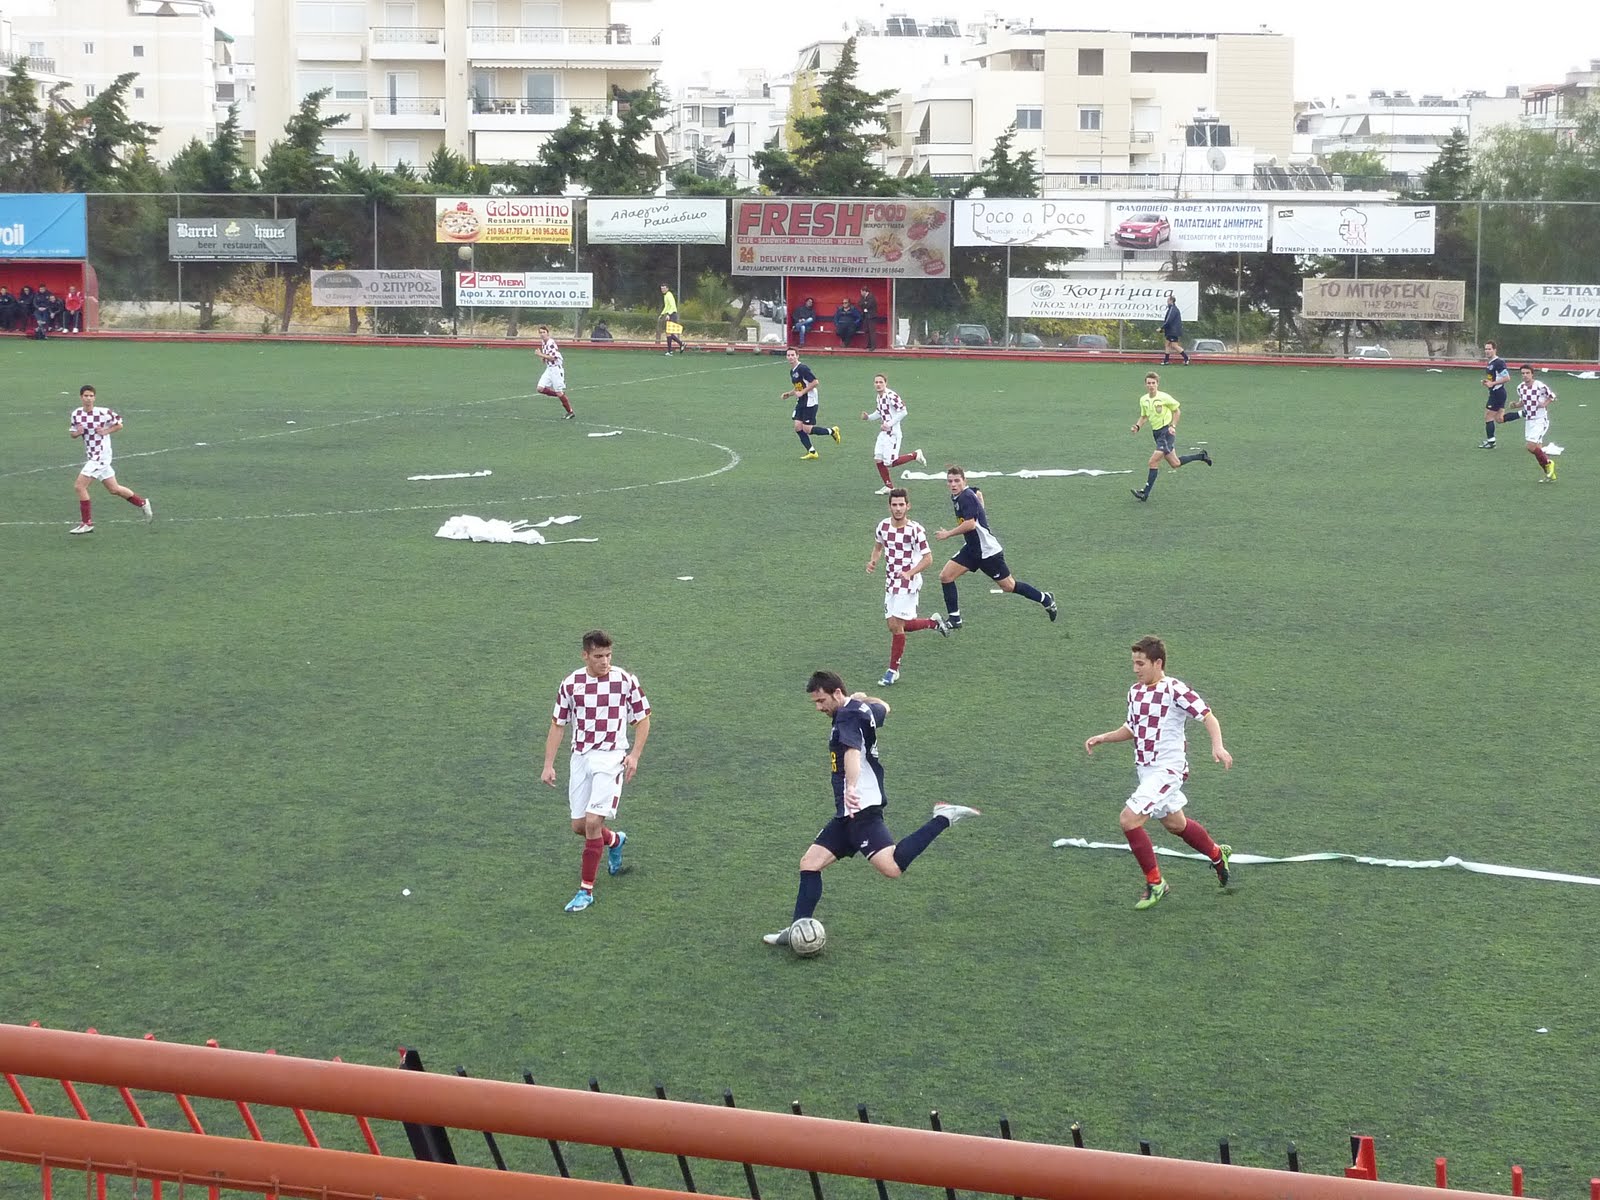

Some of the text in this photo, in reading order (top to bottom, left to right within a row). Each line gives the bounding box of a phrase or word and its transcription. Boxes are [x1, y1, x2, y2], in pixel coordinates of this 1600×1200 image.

[486, 201, 569, 217] Gelsomino
[971, 203, 1086, 227] Poco a Poco
[737, 202, 906, 236] FRESH FOOD
[1223, 218, 1263, 229] ΔΗΜΗΤΡΗΣ
[176, 223, 285, 239] Barrel haus
[197, 241, 267, 250] beer restaurant
[760, 255, 797, 263] DELIVERY
[499, 290, 566, 299] ΖΩΓΟΠΟΥΛΟΙ
[1062, 283, 1174, 301] Κοσμήματα
[1320, 281, 1341, 298] ΤΟ
[1346, 282, 1431, 299] ΜΠΙΦΤΕΚΙ
[1031, 301, 1066, 309] ΝΙΚΟΣ
